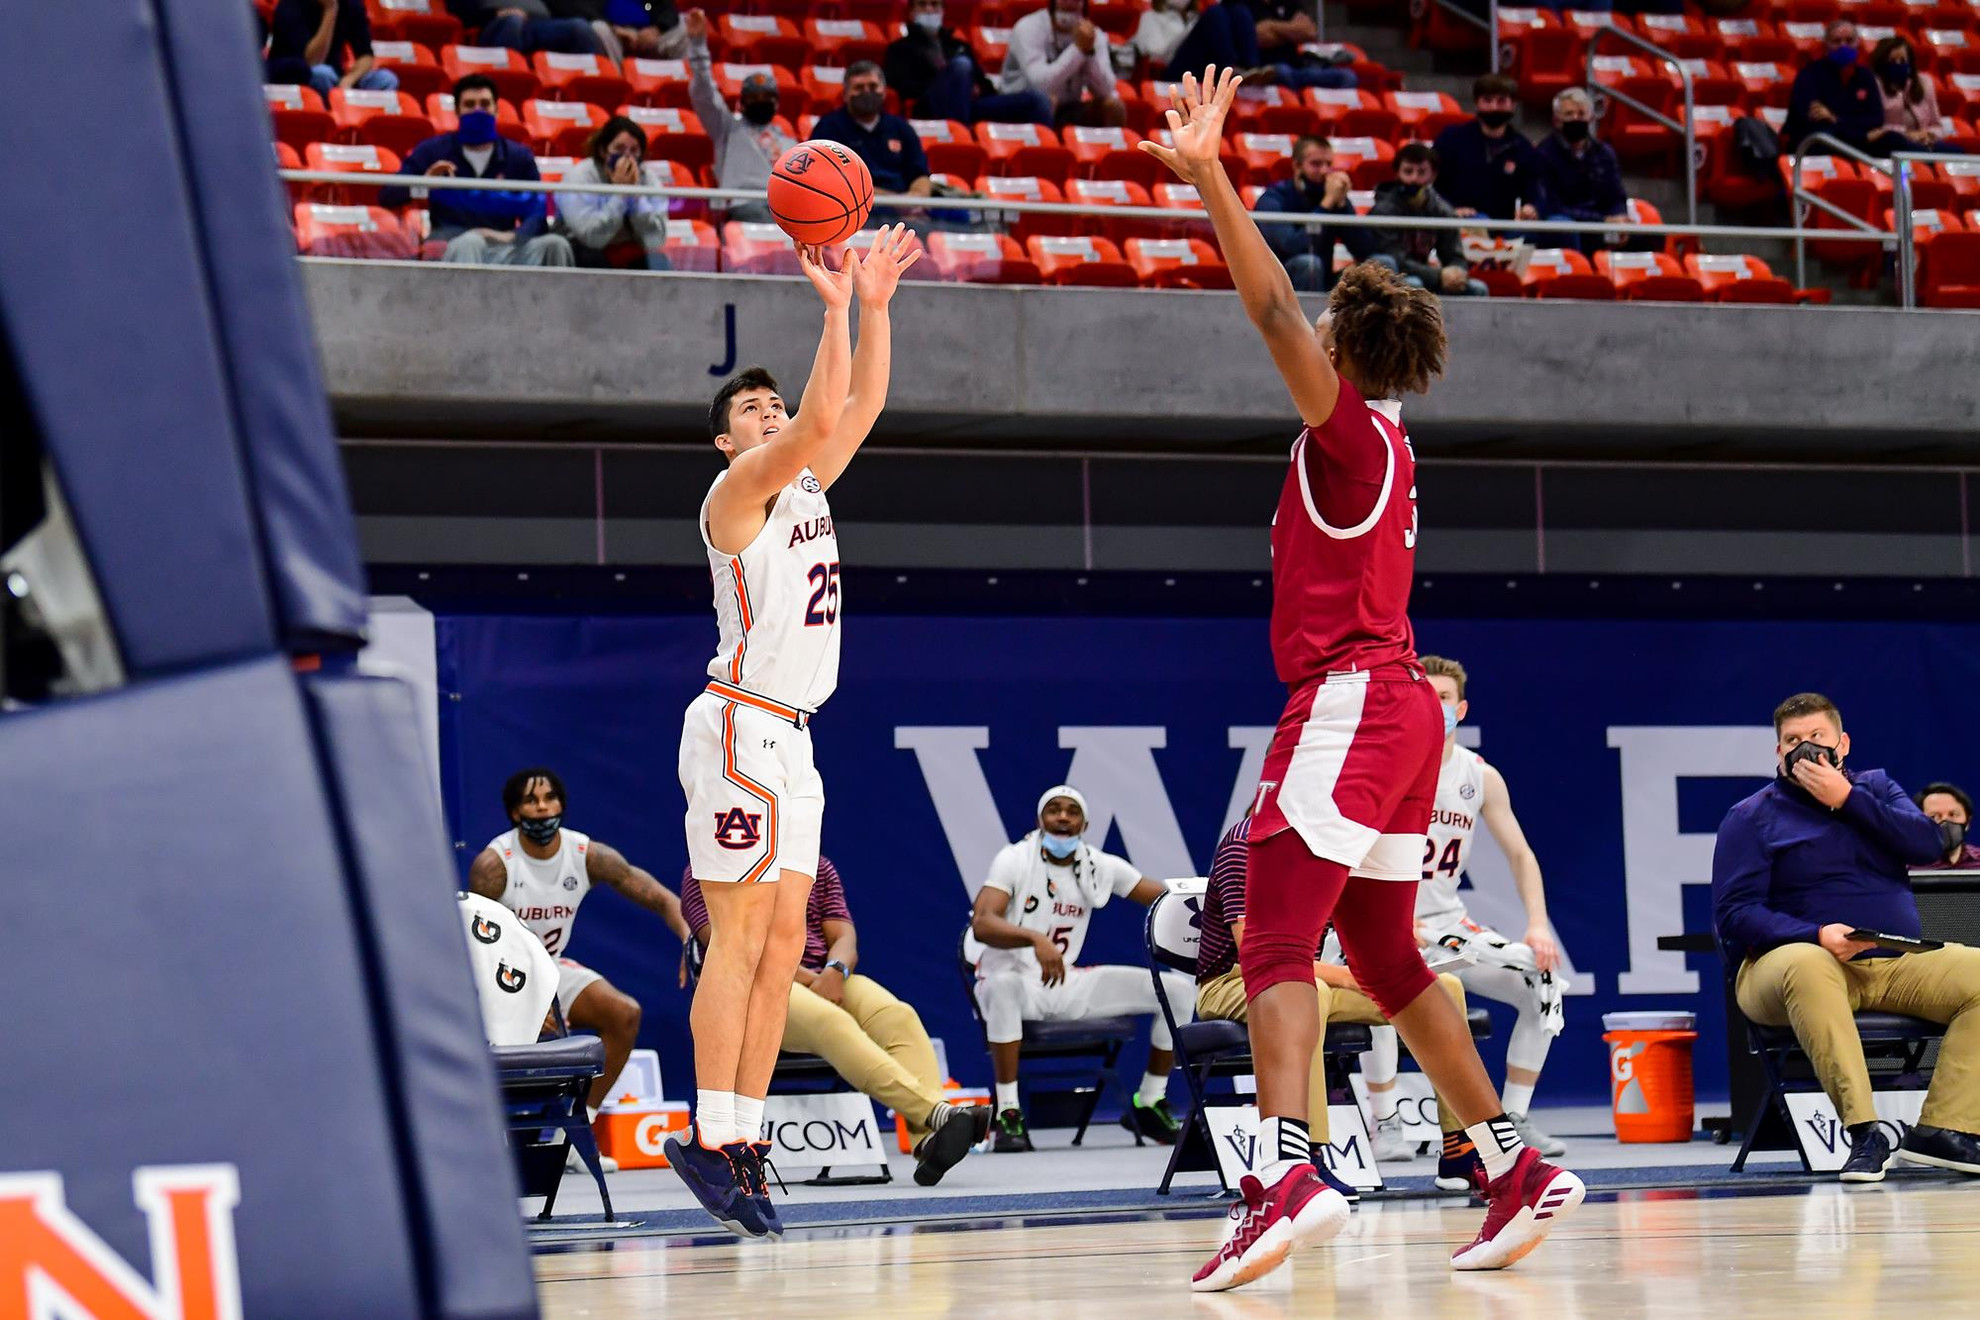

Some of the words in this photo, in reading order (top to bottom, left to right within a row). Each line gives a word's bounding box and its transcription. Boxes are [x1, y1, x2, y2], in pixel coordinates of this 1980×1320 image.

[707, 303, 737, 378] J
[804, 561, 840, 627] 25
[1422, 838, 1462, 880] 24
[511, 905, 574, 921] UBURN
[1612, 1048, 1634, 1082] G
[635, 1114, 670, 1156] G
